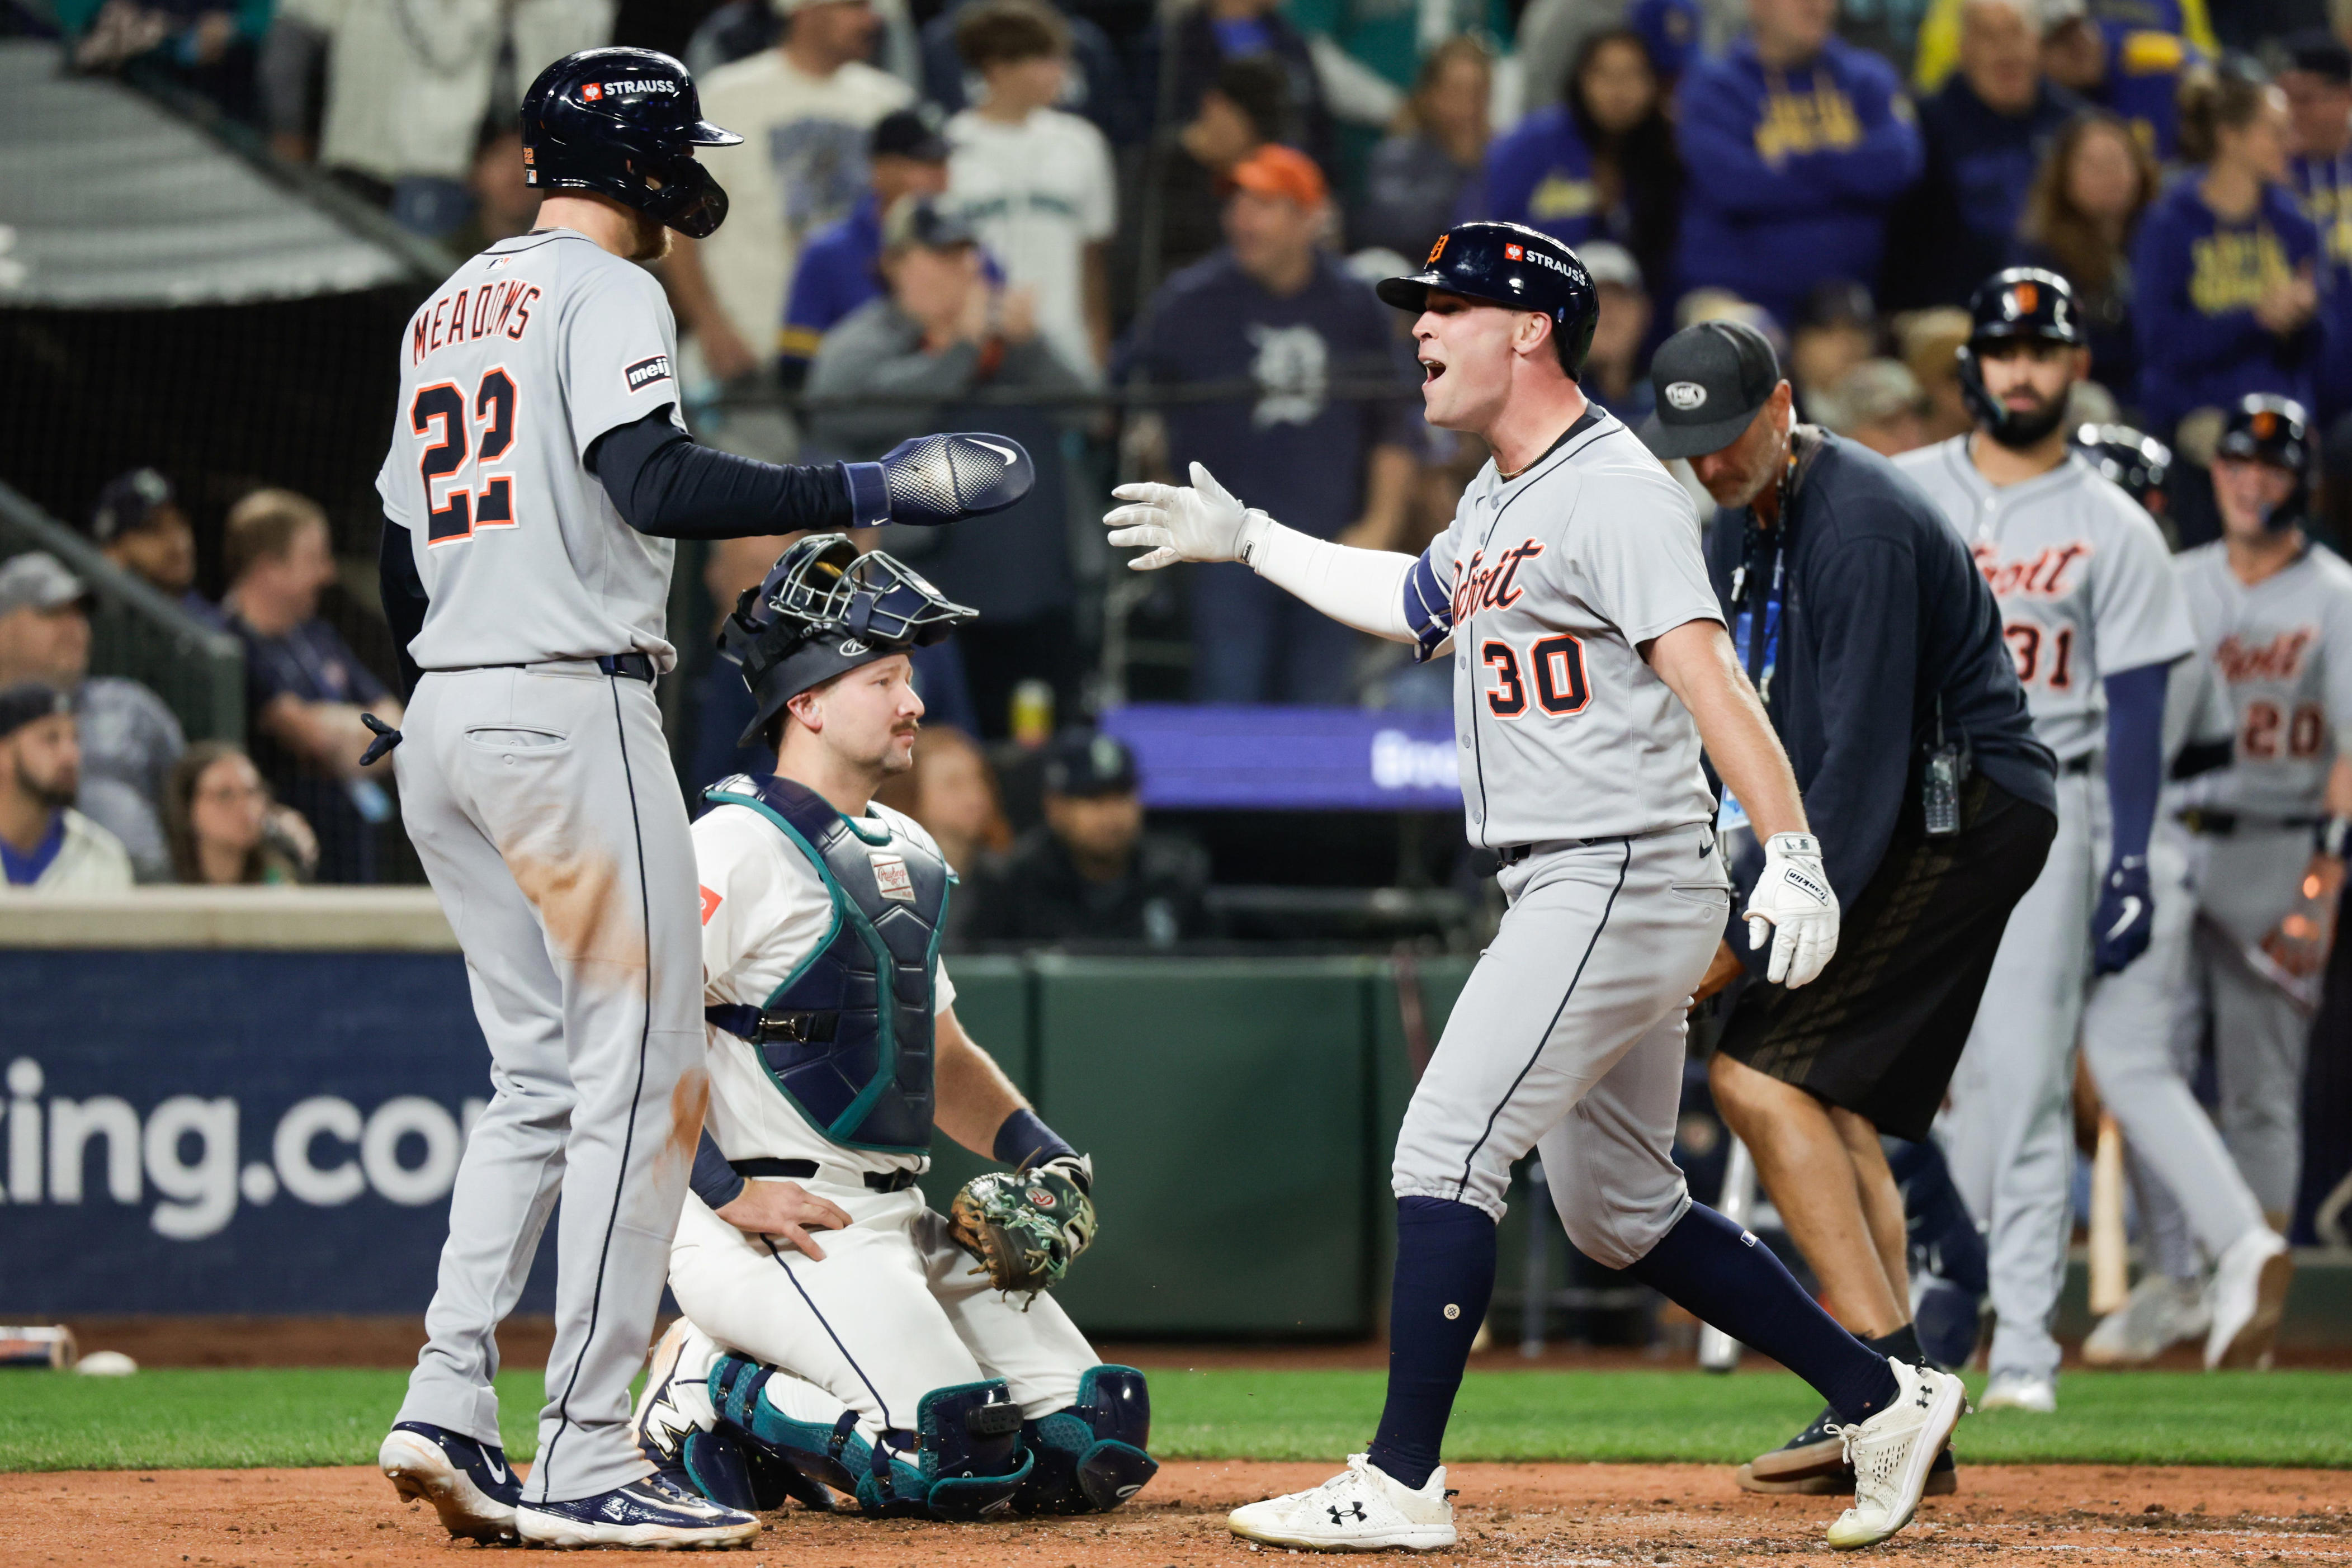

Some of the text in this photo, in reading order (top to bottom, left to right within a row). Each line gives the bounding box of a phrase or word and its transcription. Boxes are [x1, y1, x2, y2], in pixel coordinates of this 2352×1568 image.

[604, 80, 676, 96] STRAUSS
[1526, 249, 1586, 286] STRAUSS
[413, 278, 542, 370] MEADOWS
[629, 357, 671, 385] meij
[408, 362, 521, 550] 22
[1480, 632, 1594, 721] 30
[2002, 620, 2075, 691] 31
